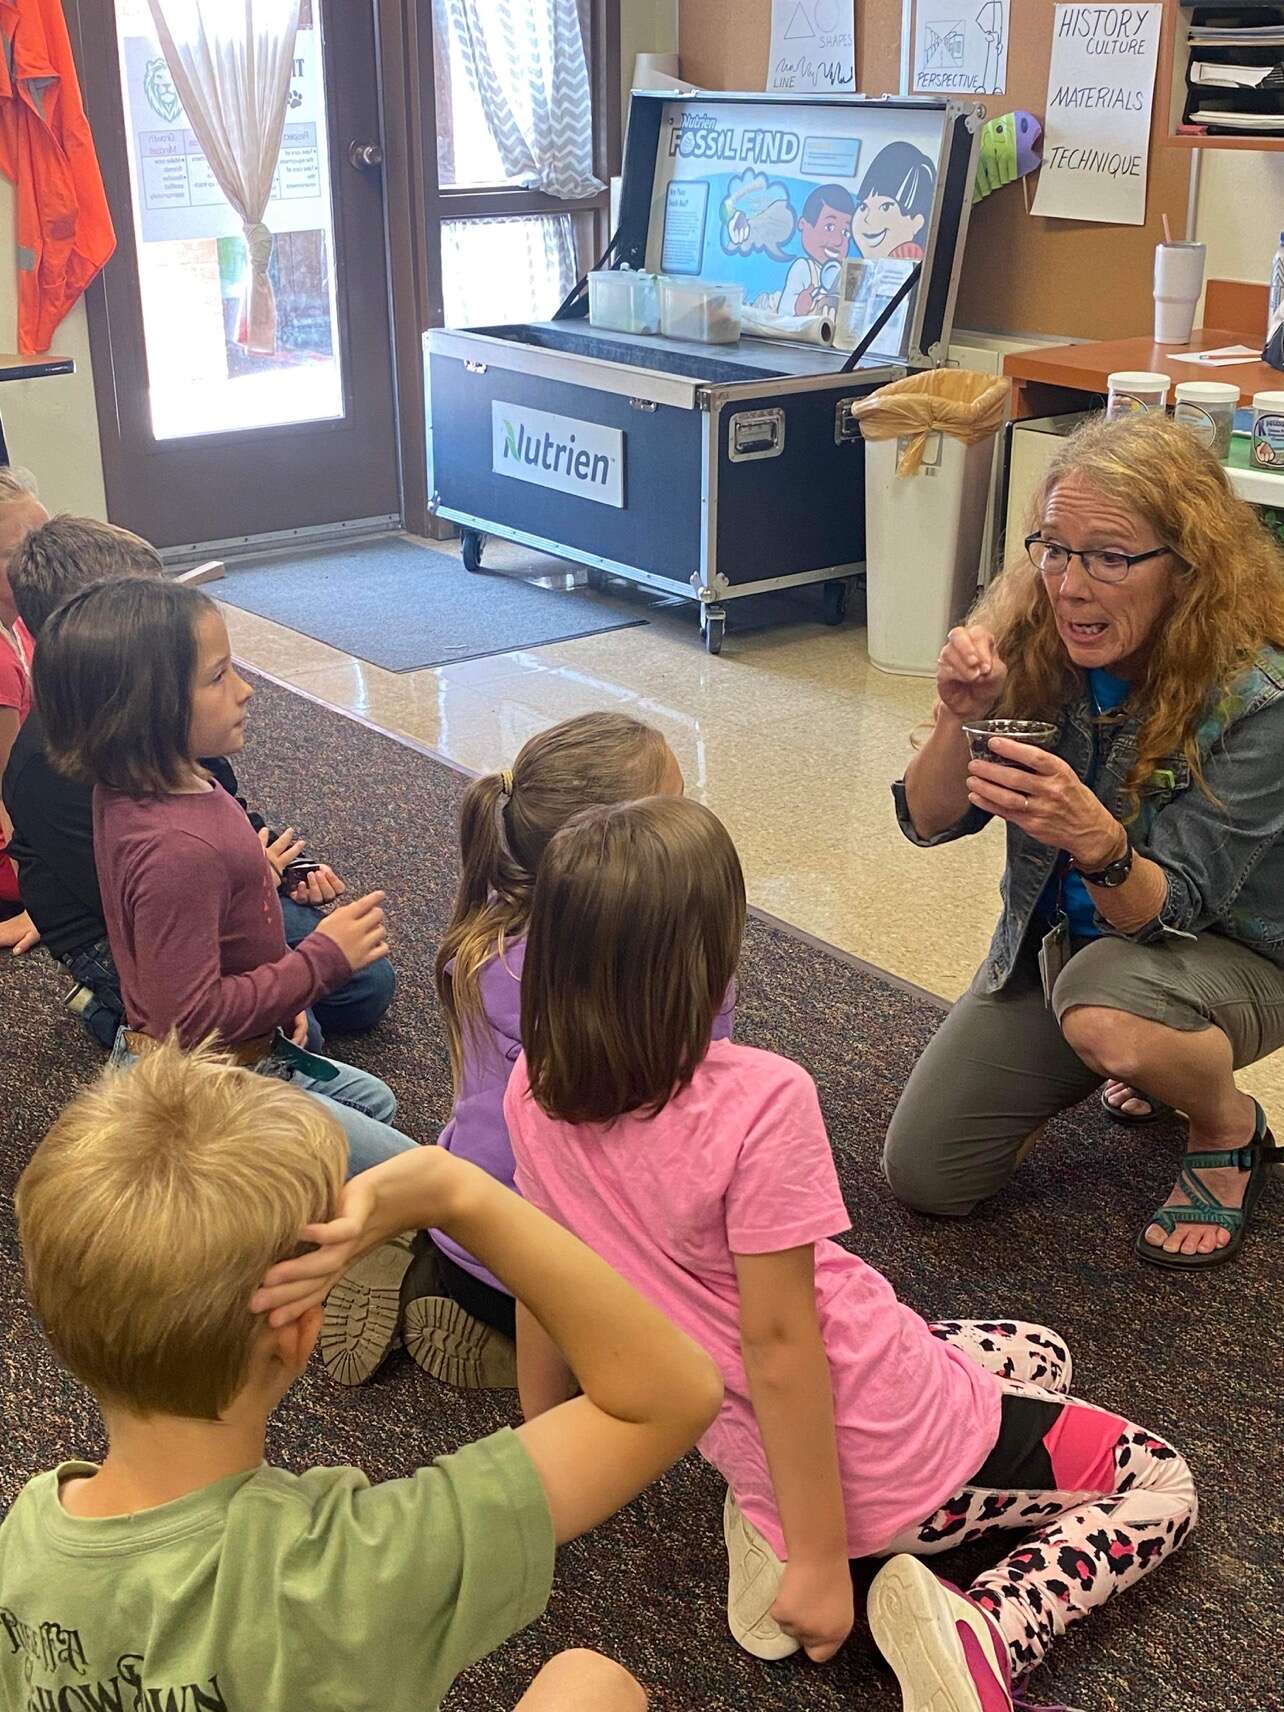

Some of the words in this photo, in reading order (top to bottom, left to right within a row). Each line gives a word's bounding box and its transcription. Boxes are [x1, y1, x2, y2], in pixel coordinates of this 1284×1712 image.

[1058, 8, 1149, 38] HISTORY
[818, 33, 852, 48] SHAPES
[1086, 37, 1145, 55] CULTURE
[773, 75, 796, 89] LINE
[917, 71, 979, 89] PERSPECTIVE
[1050, 86, 1143, 111] MATERIALS
[681, 111, 717, 129] Nutrien
[668, 127, 738, 161] FOSSIL
[739, 128, 800, 164] FIND
[1049, 146, 1142, 179] TECHNIQUE
[503, 418, 610, 485] Nutrien
